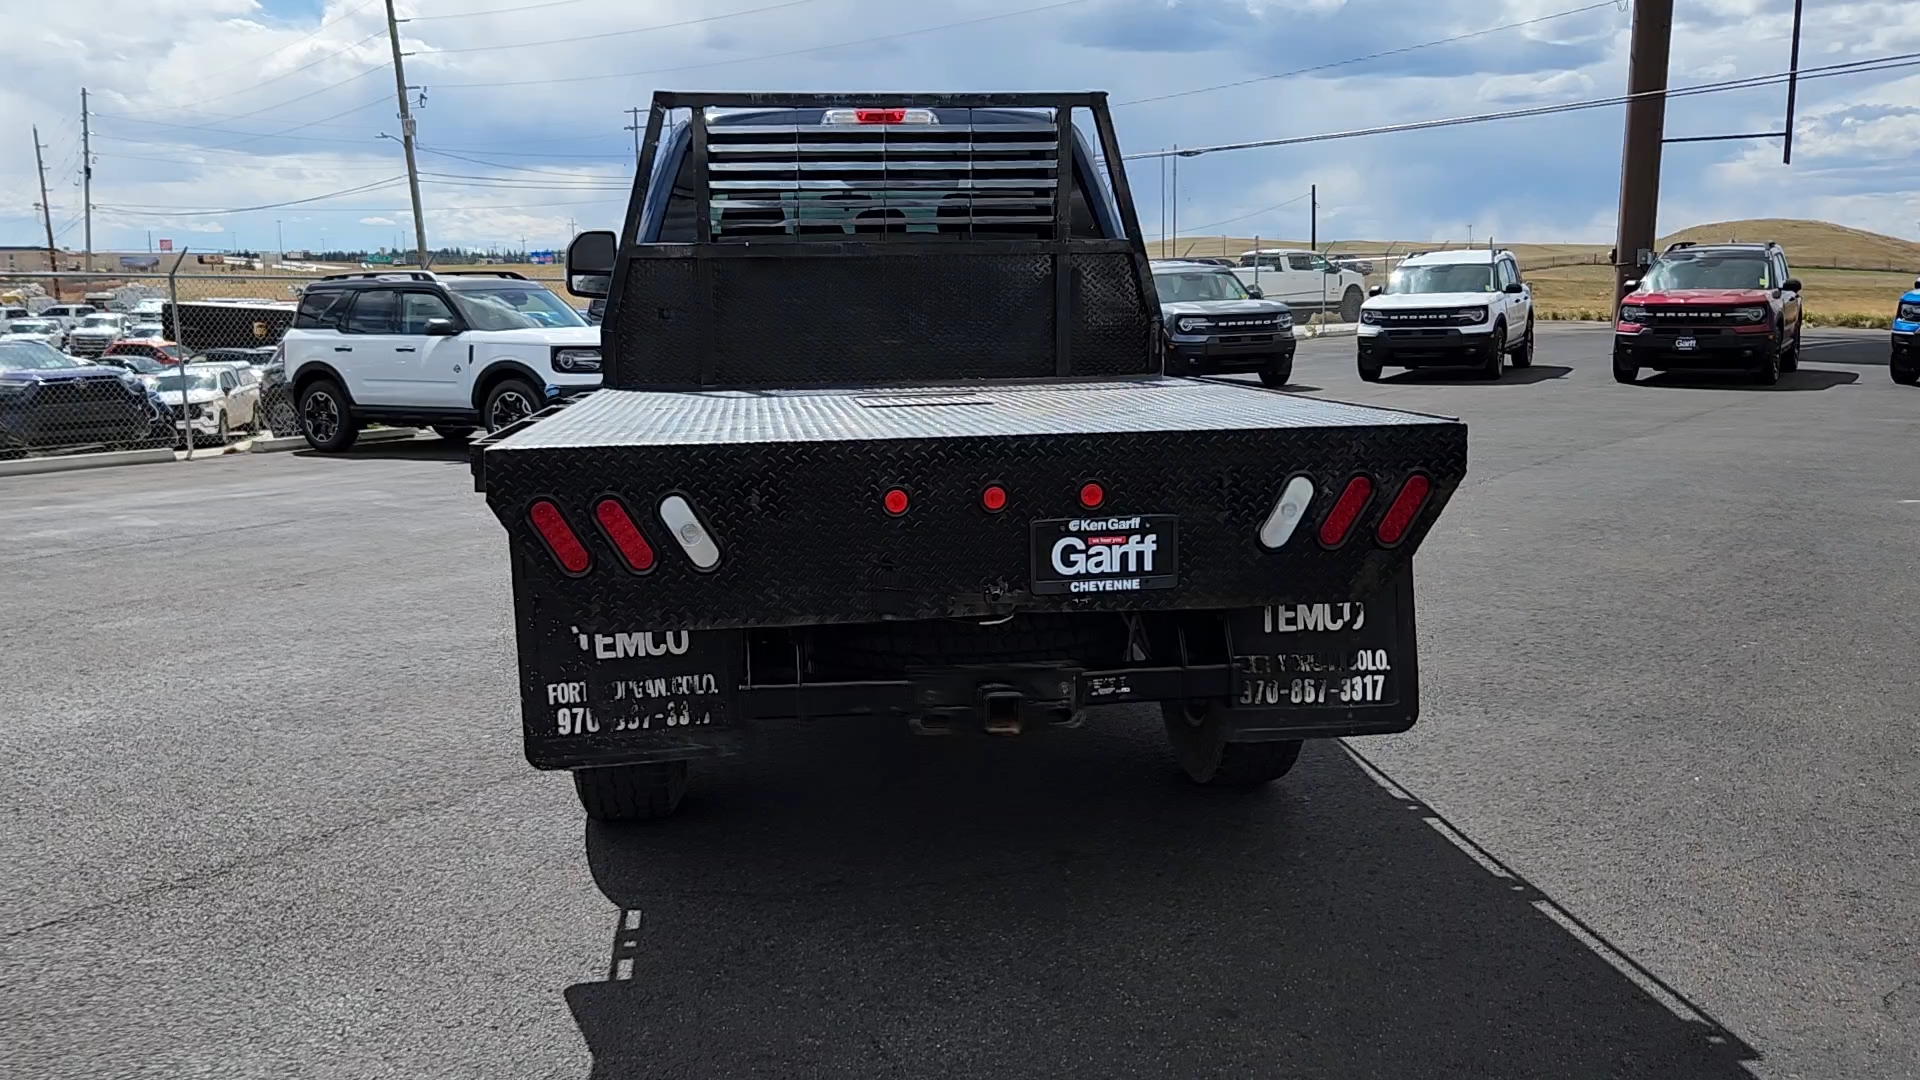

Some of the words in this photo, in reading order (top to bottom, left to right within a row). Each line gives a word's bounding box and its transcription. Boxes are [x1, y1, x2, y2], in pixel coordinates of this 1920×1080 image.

[1080, 519, 1107, 531] Ken
[1107, 516, 1141, 530] Garff
[1051, 533, 1157, 576] Garff
[1070, 578, 1140, 593] CHEYENNE
[1350, 649, 1391, 671] OLO.
